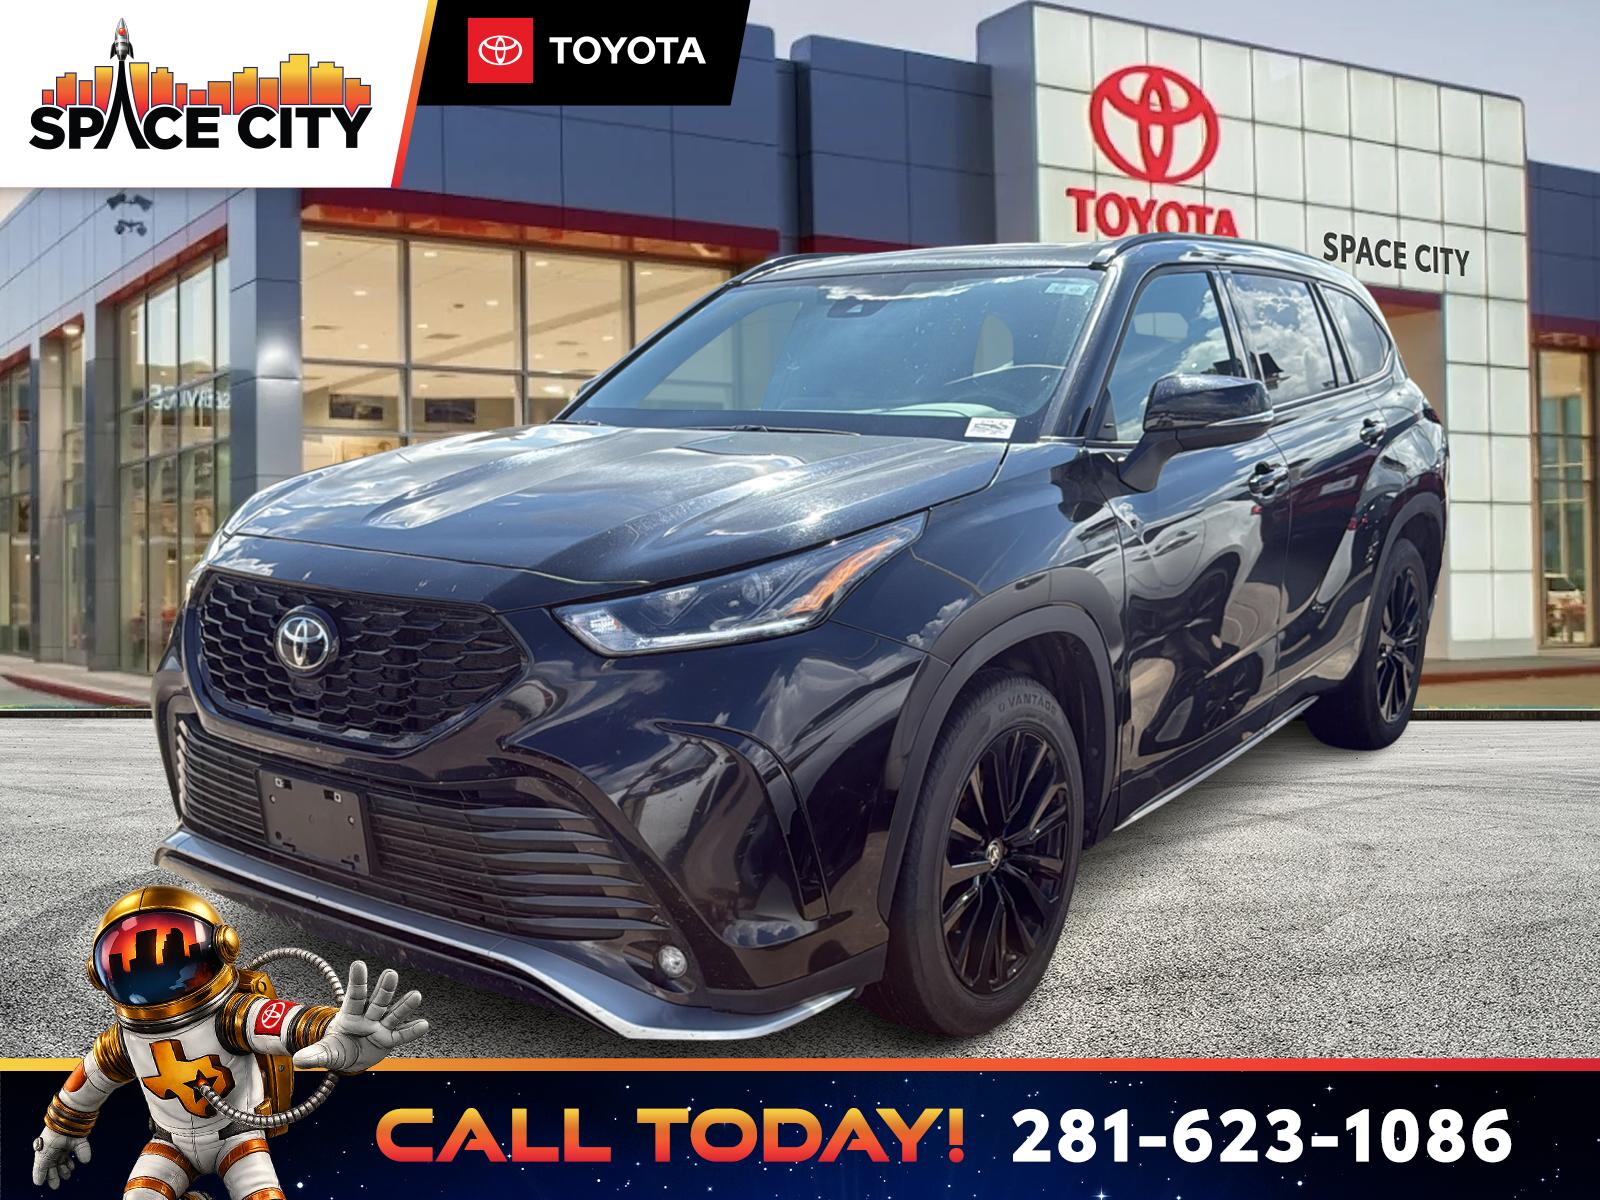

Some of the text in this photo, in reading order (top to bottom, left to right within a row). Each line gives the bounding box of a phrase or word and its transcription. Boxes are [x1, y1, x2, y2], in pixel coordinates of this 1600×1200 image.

[1066, 187, 1239, 238] TOYOTA
[1323, 232, 1470, 277] SPACE CITY
